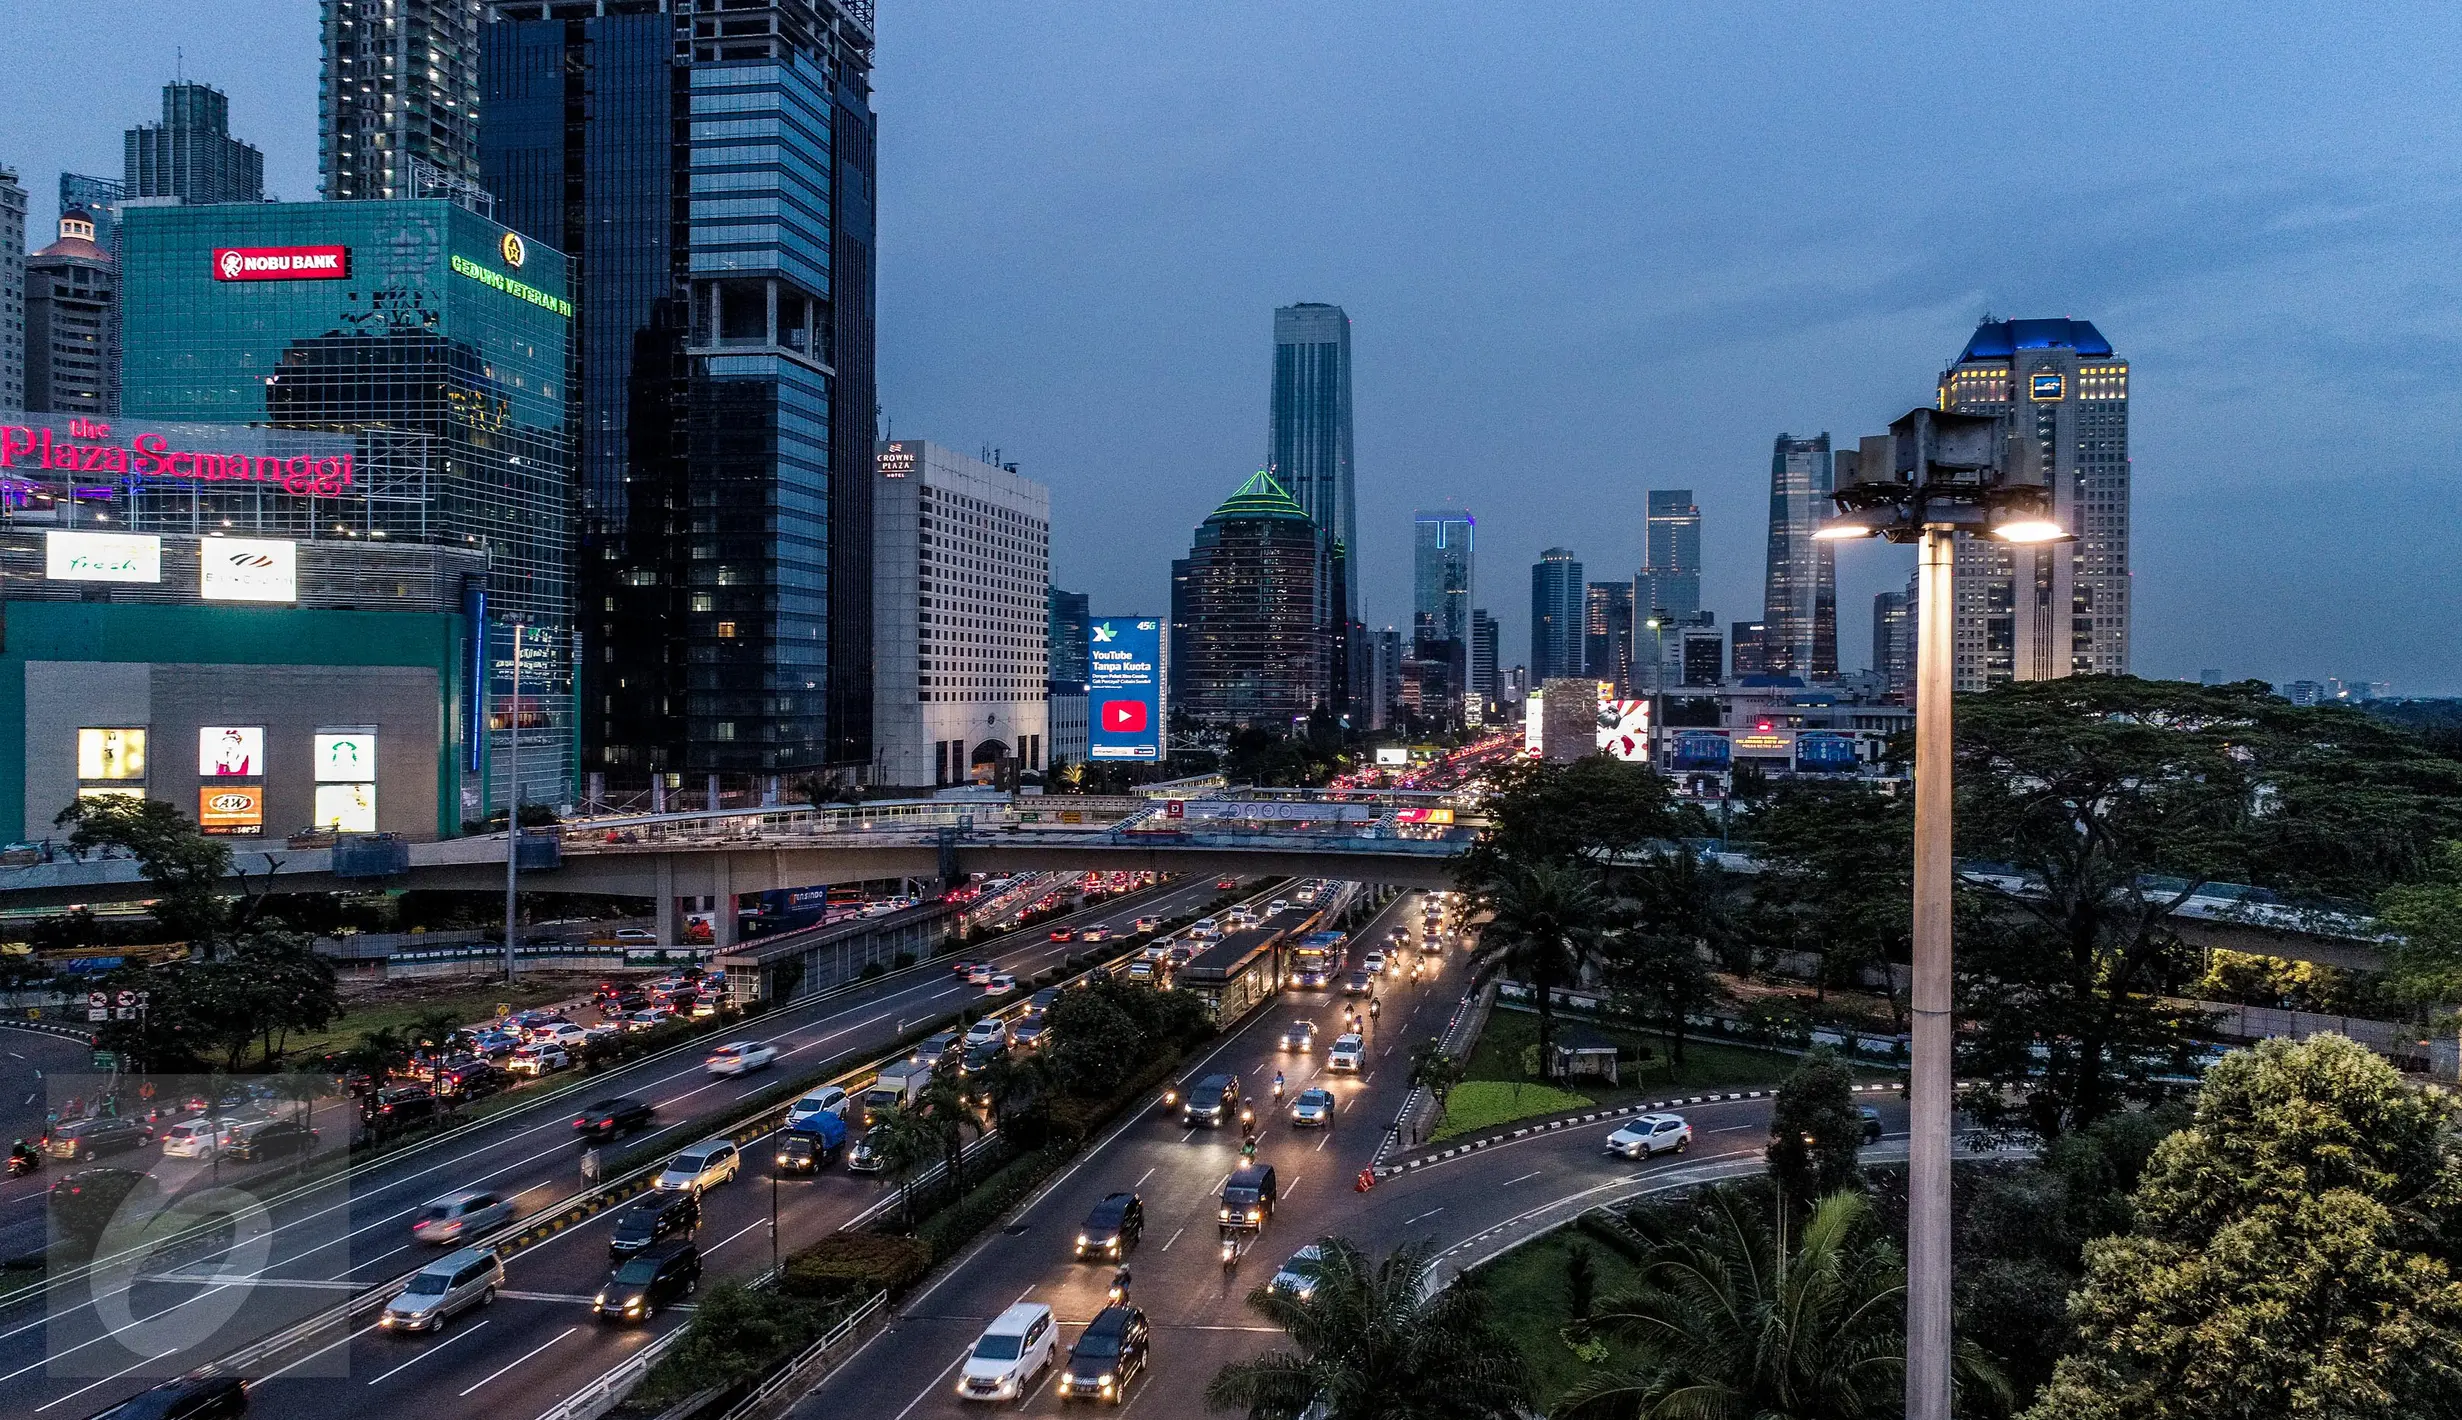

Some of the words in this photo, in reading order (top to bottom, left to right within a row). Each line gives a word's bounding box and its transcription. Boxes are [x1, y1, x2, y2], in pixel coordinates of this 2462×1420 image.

[244, 256, 290, 271] NOBU
[292, 255, 338, 269] BANK
[451, 255, 504, 290] GEDUNG
[505, 277, 558, 312] VETERAN
[559, 299, 571, 317] RI
[69, 417, 111, 440] the
[0, 425, 128, 474] Plaza
[134, 432, 353, 498] Semanggi
[876, 454, 915, 462] CROWNE
[882, 462, 910, 470] PLAZA
[1092, 651, 1133, 660] YouTube
[1092, 662, 1121, 673] Tanpa
[1123, 662, 1151, 671] Kuota
